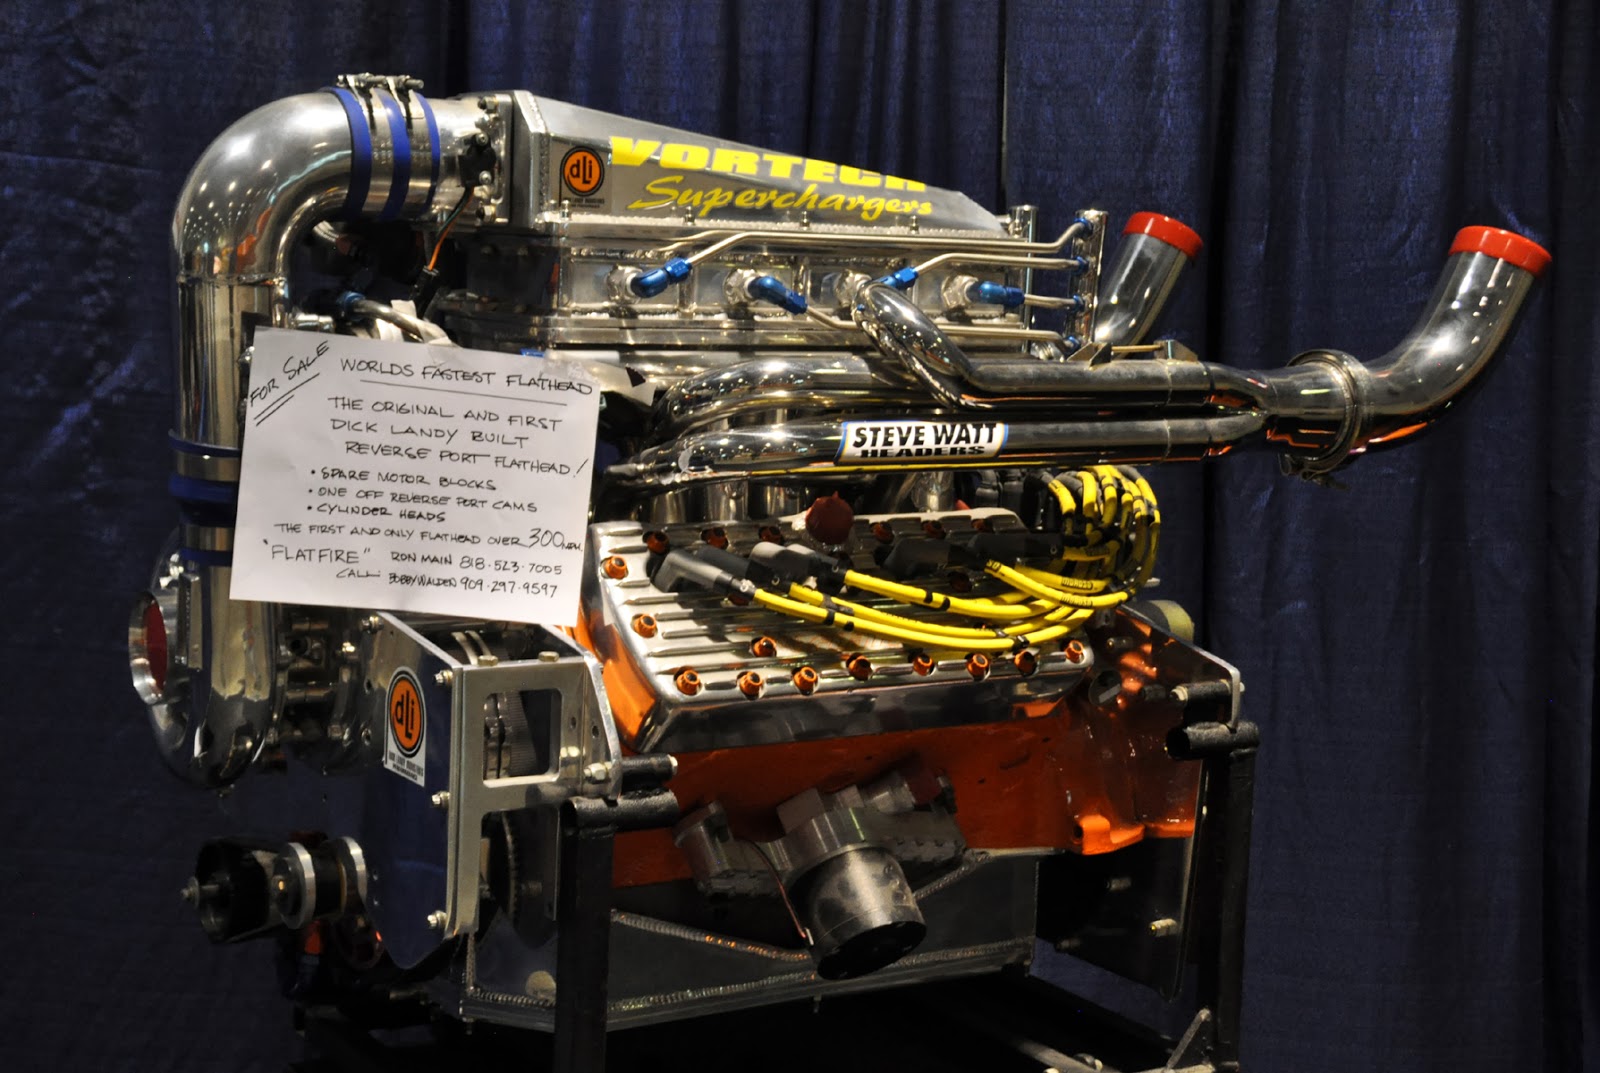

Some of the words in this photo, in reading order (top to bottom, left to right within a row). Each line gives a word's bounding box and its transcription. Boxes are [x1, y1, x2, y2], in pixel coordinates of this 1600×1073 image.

[627, 175, 932, 221] Superchargers
[249, 378, 279, 407] FOR
[282, 340, 330, 380] SALE
[341, 358, 415, 377] WORLDS
[421, 366, 496, 385] FASTEST
[506, 371, 593, 395] FLATHEAD
[328, 396, 363, 411] THE
[371, 401, 454, 418] ORIGINAL
[464, 410, 500, 422] AND
[508, 415, 563, 432] FIRST
[330, 418, 378, 433] DICK
[391, 425, 458, 444] LANDY
[471, 431, 529, 448] BUILT
[852, 425, 926, 448] STEVE
[931, 422, 997, 446] WATT
[345, 441, 432, 459] REVERSE
[439, 450, 491, 464] PORT
[860, 446, 985, 459] HEADERS
[321, 467, 370, 481] SPARE
[378, 472, 430, 485] MOTOR
[439, 476, 497, 491] BLOCKS
[317, 503, 392, 516] CYLINDER
[400, 509, 446, 523] HEADS
[318, 487, 347, 498] ONE
[356, 490, 384, 500] OFF
[390, 492, 452, 506] REVERSE
[456, 497, 488, 509] PORT
[492, 500, 538, 513] CAMS
[274, 523, 302, 534] THE
[309, 525, 345, 535] FIRST
[350, 527, 381, 536] AND
[384, 529, 415, 541] ONLY
[420, 531, 481, 545] FLATHEAD
[487, 535, 529, 549] OVER
[391, 551, 417, 563] RON
[421, 554, 452, 565] MAIN
